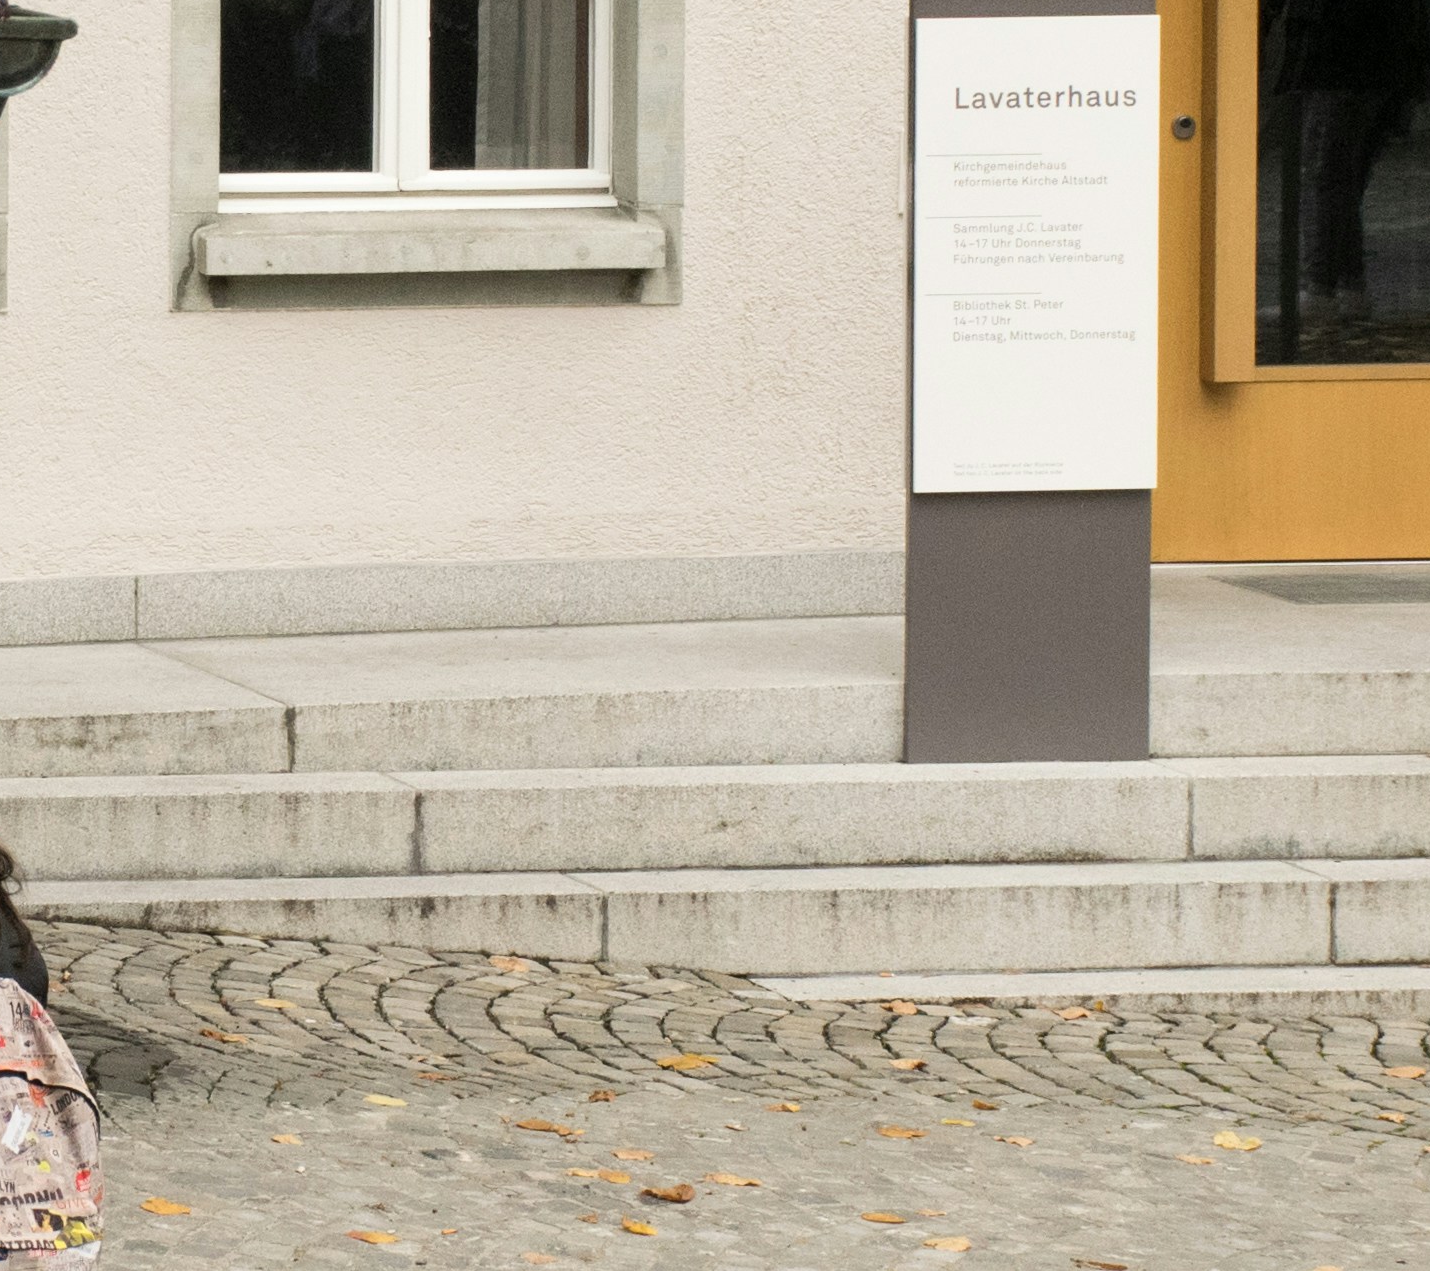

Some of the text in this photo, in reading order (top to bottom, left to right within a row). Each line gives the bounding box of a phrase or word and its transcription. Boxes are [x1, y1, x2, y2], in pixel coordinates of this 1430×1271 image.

[956, 85, 1136, 109] Lavaterhaus
[954, 161, 1066, 174] Kirchgemeindehaus
[954, 175, 1107, 187] reformierte Kirche Altstadt
[954, 222, 1082, 235] Sammlung J.C. Lavater
[992, 239, 1011, 248] Uhr
[1015, 238, 1081, 250] Donnerstag
[953, 253, 1124, 266] Führungen nach Vereinbarung
[953, 299, 1063, 311] Bibliothek St. Peter
[992, 316, 1011, 325] Uhr
[953, 330, 1135, 343] Dienstag, Mittwoch, Donnerstag
